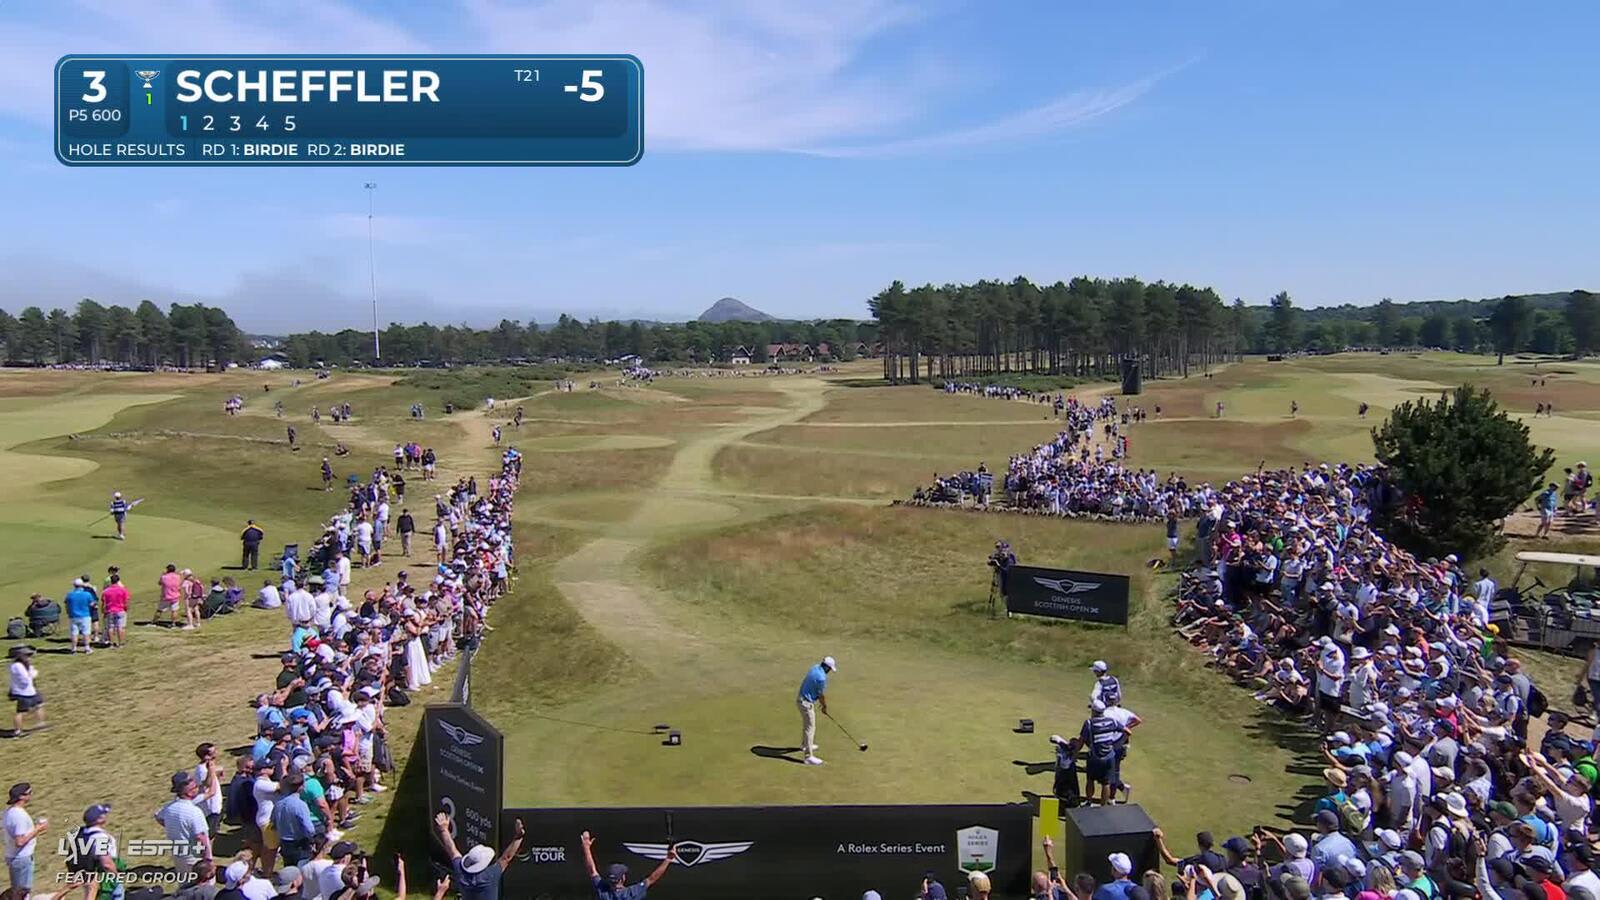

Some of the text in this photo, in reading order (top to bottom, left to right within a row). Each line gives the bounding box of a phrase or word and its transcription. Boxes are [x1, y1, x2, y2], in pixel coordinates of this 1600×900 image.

[837, 843, 945, 853] A Rolex Series Event
[533, 852, 565, 862] TOUR
